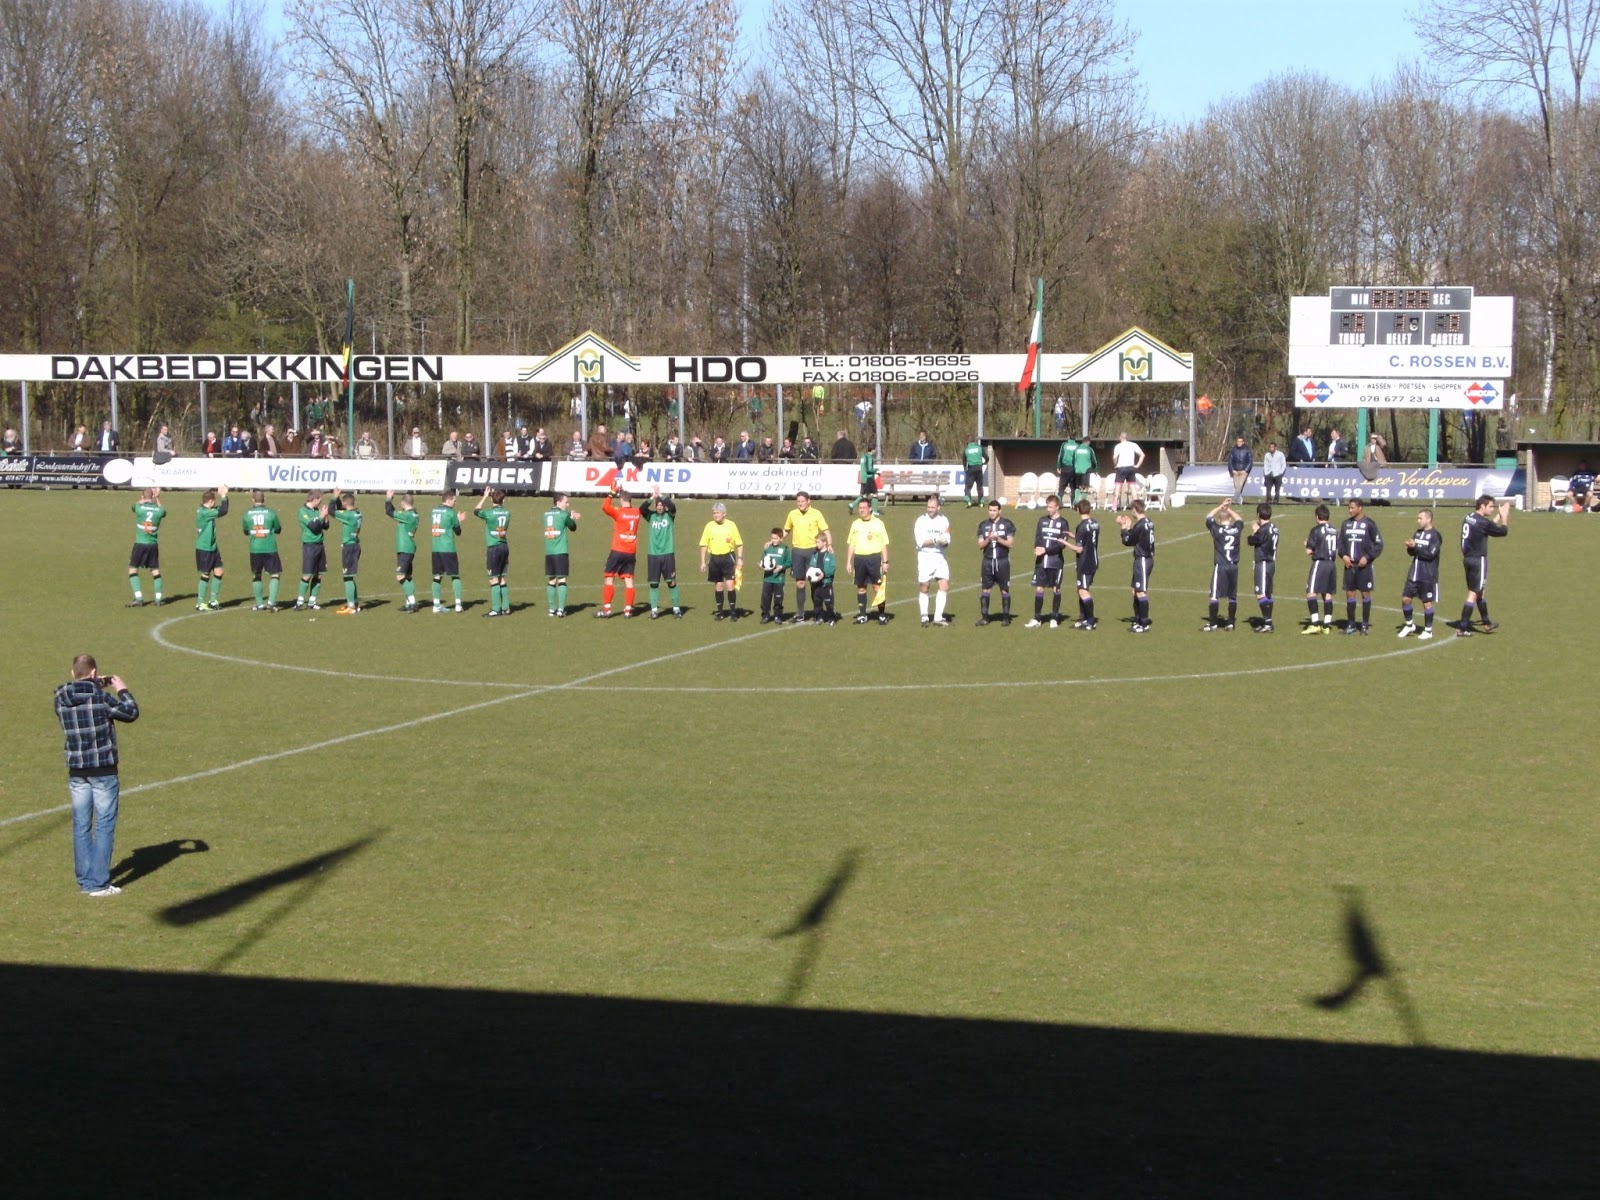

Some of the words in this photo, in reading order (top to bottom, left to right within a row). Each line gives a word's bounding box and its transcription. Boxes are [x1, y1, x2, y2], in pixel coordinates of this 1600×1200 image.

[1351, 293, 1369, 305] MIN
[1433, 293, 1451, 305] SEC
[1386, 333, 1413, 345] HELFT
[1430, 333, 1464, 345] GASTEN
[801, 356, 844, 368] TEL.:
[848, 355, 971, 367] 01806-19695
[1389, 355, 1404, 367] C.
[1409, 355, 1476, 368] ROSSEN
[1482, 356, 1509, 368] B.V.
[51, 355, 444, 381] DAKBEDEKKINGEN
[667, 356, 767, 383] HDO
[802, 371, 844, 382] FAX:
[848, 371, 980, 382] 01806-20026
[268, 465, 338, 482] Velicom
[455, 467, 534, 484] QUICK
[729, 466, 823, 477] www.dakned.nl
[1246, 476, 1358, 486] SCDERSBEDRIJF
[1397, 467, 1472, 487] Verhoeven
[740, 482, 760, 491] 073
[792, 482, 803, 491] 12
[808, 482, 822, 491] 50
[1300, 487, 1320, 497] 06
[1343, 488, 1363, 498] 29
[1371, 488, 1390, 498] 53
[1398, 488, 1418, 498] 40
[1427, 488, 1445, 498] 12
[145, 511, 153, 522] 2
[252, 514, 265, 526] 10
[498, 516, 507, 527] 17
[1462, 523, 1470, 539] 9
[1224, 535, 1235, 550] 2
[1325, 535, 1337, 551] 11
